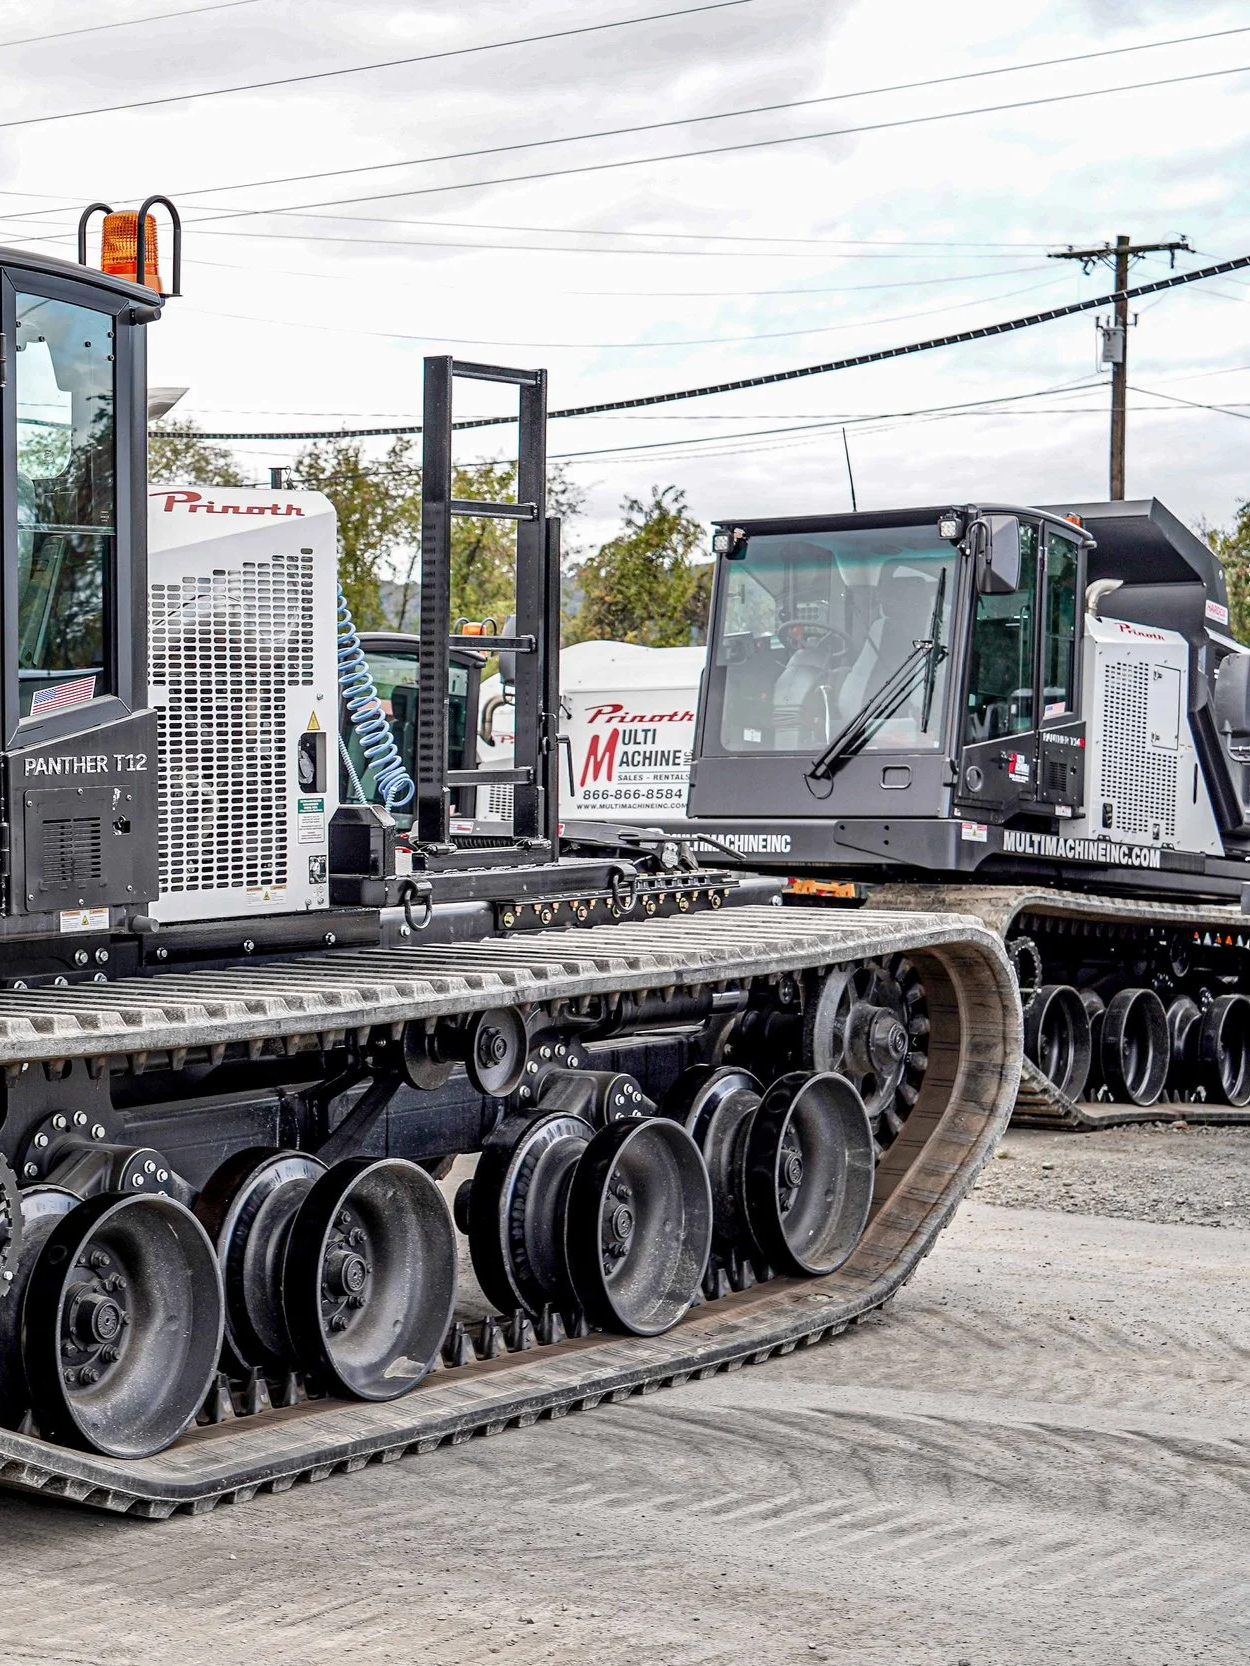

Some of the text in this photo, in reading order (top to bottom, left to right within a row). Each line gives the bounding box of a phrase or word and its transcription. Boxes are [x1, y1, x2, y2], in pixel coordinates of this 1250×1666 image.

[149, 490, 305, 516] Prinoth
[1113, 622, 1165, 641] Prinoth
[584, 704, 694, 724] Prinoth
[24, 753, 148, 776] PANTHER T12
[653, 773, 690, 781] RENTALS
[582, 788, 683, 800] 866-866-8584
[1003, 831, 1161, 868] MULTIMACHINEINC.COM
